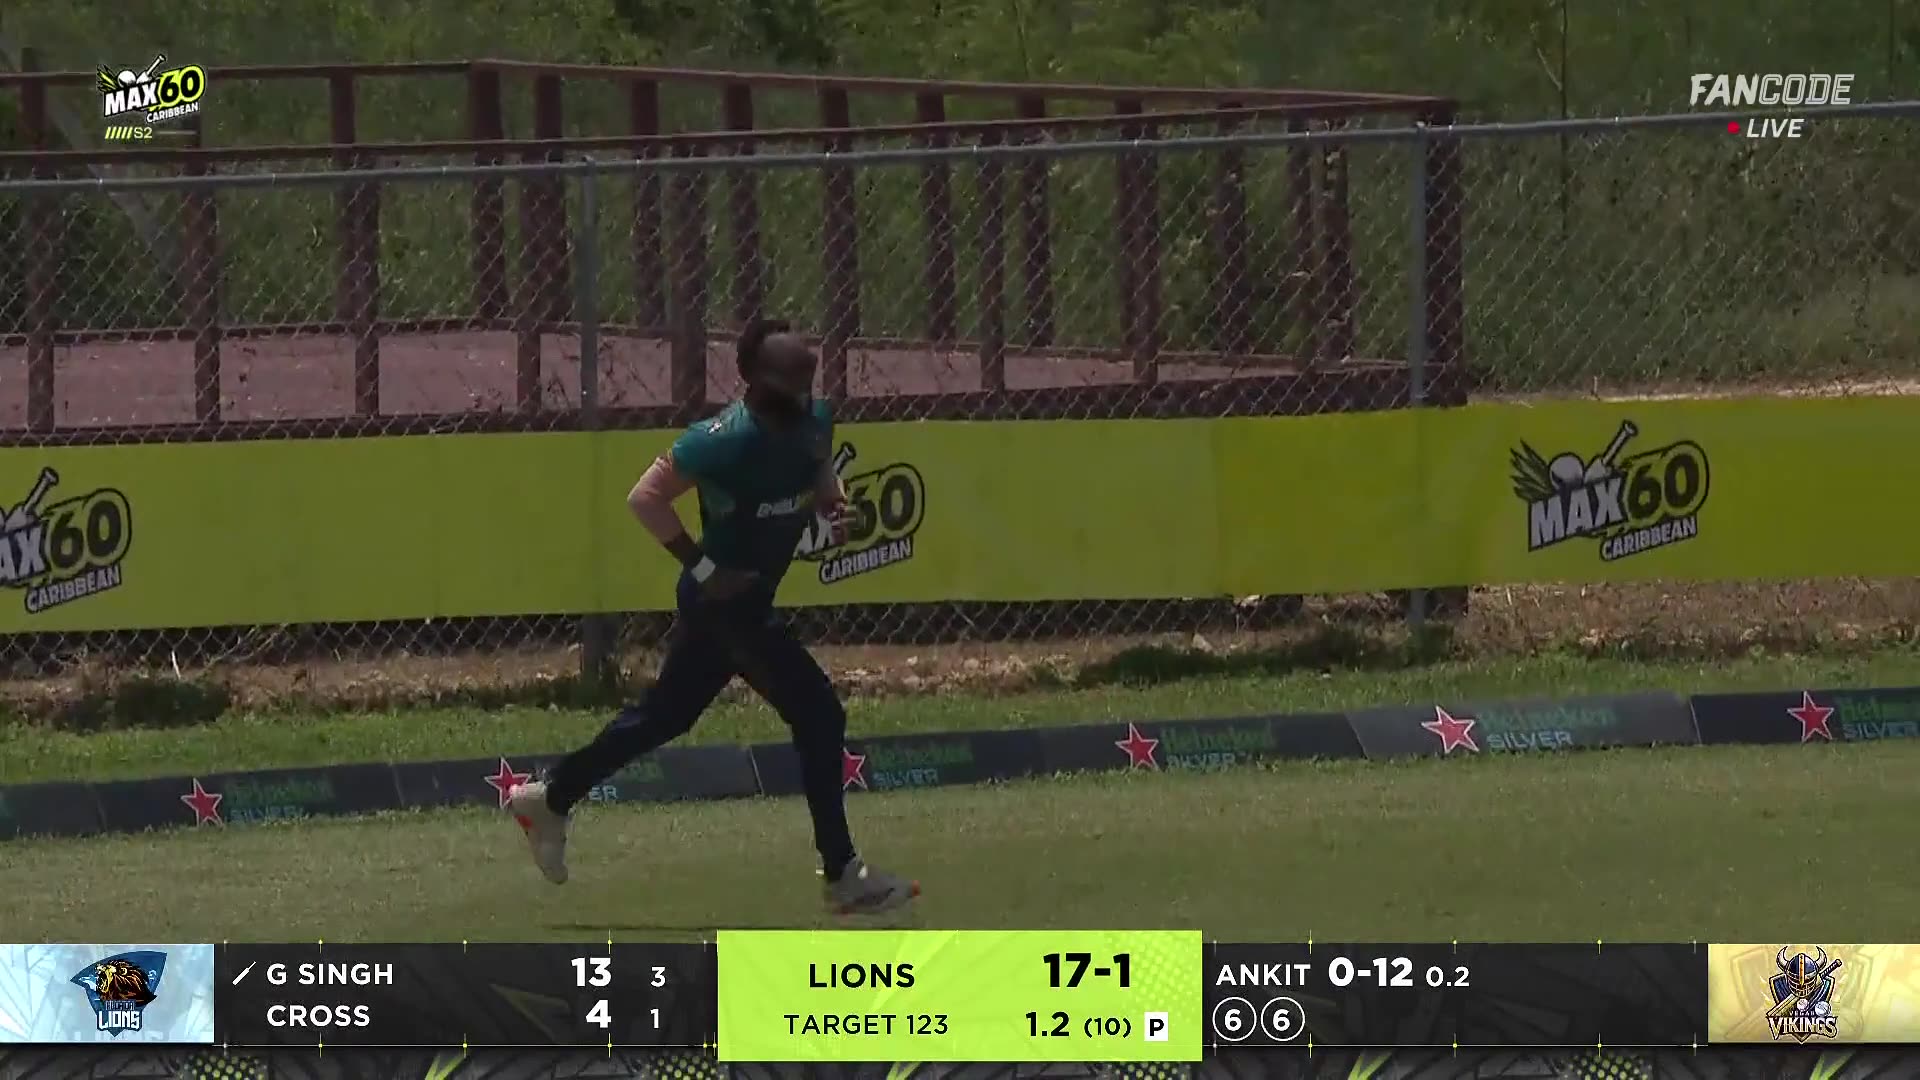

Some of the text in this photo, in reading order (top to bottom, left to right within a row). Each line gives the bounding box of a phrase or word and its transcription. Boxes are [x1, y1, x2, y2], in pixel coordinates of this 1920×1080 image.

[820, 536, 913, 585] CARIBBEAN
[1601, 513, 1698, 561] CARIBBEAN
[26, 562, 121, 613] CARIBBEAN
[1486, 731, 1573, 750] SILVER
[873, 767, 939, 787] SILVER
